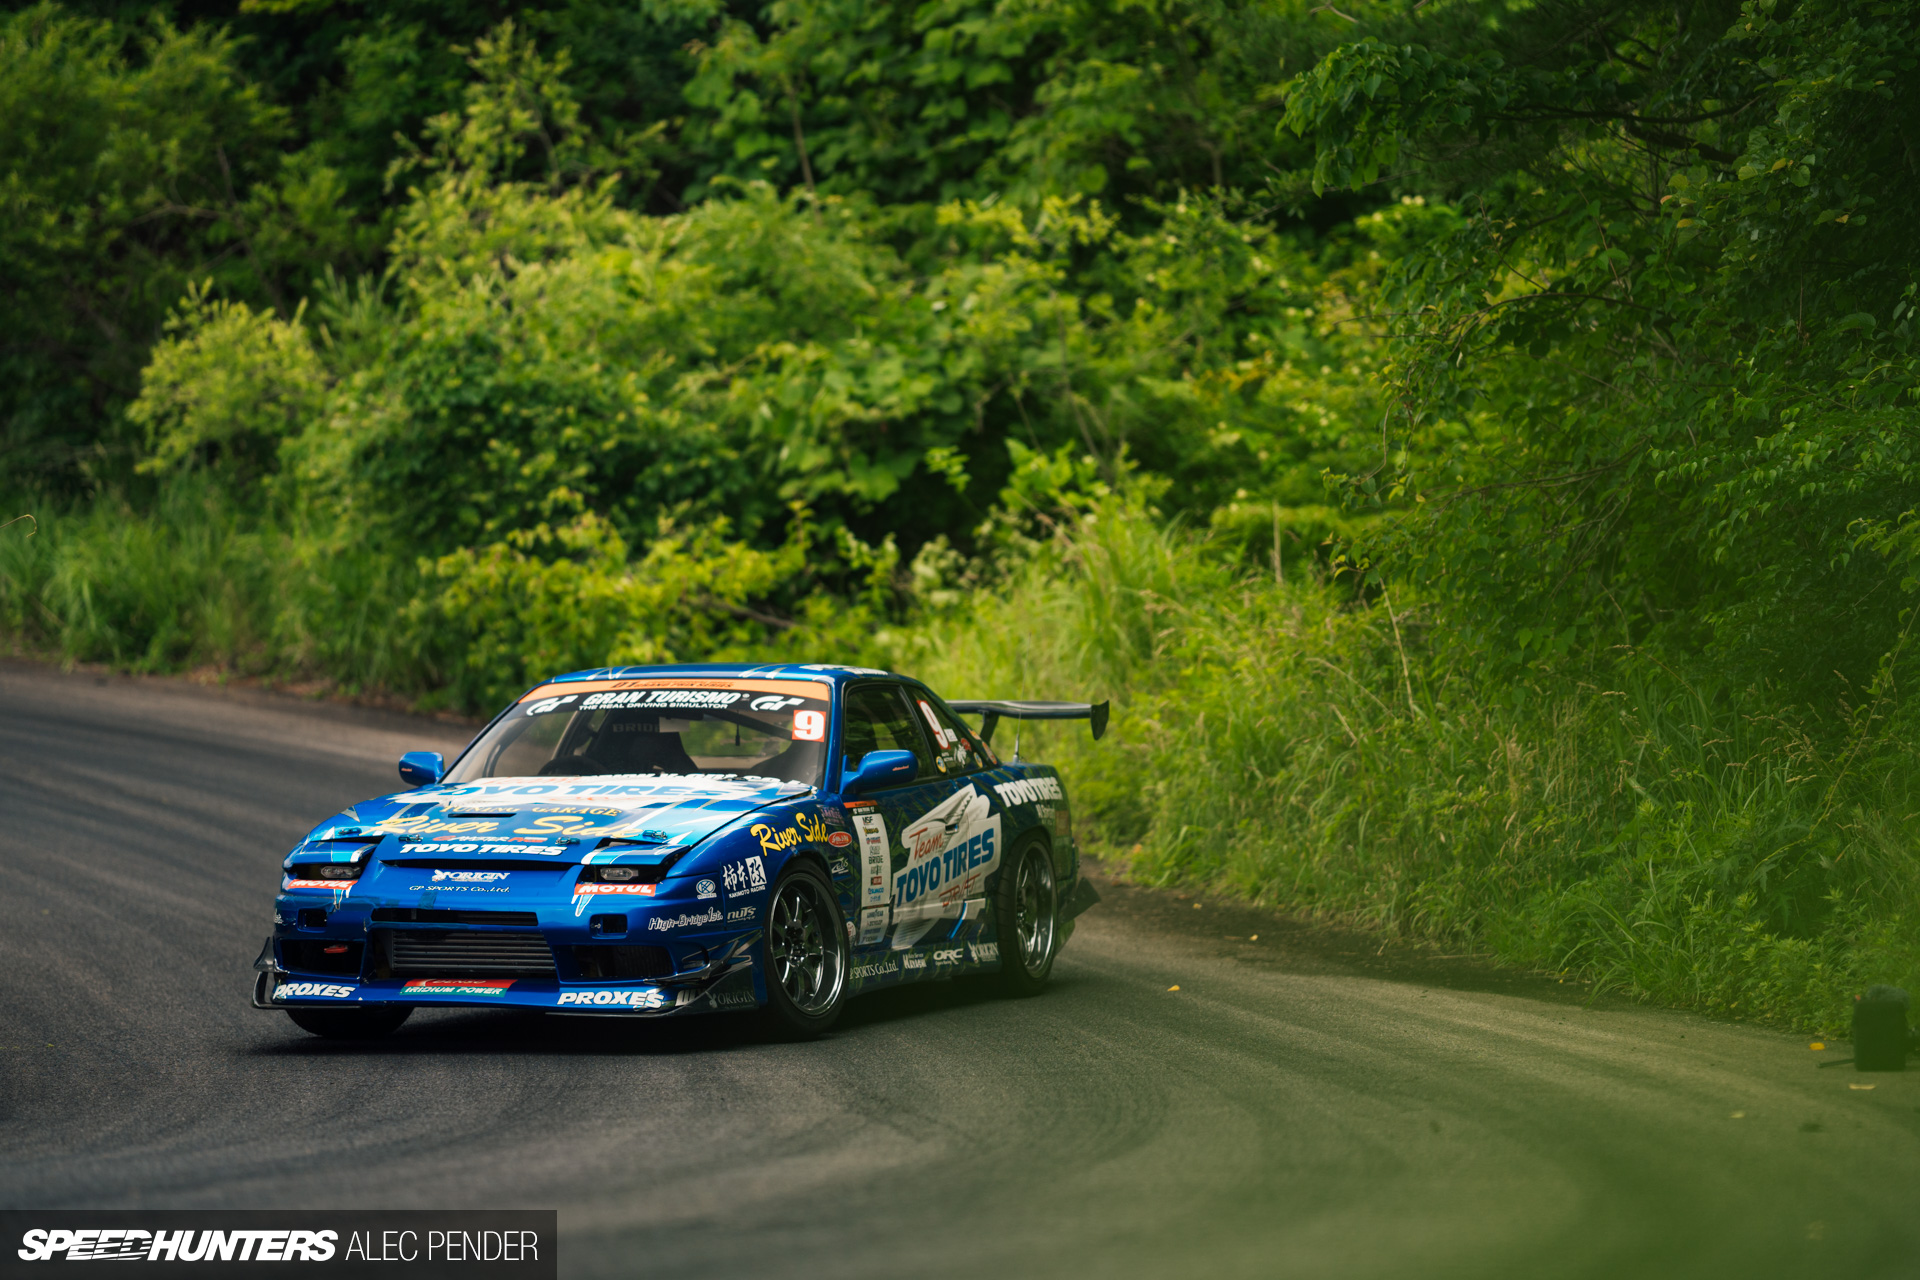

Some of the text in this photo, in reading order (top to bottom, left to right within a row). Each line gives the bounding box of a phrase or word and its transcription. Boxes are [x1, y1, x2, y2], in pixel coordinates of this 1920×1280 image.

[583, 690, 742, 706] GRAN TURISMO
[794, 710, 824, 740] 9
[920, 701, 949, 748] 9
[563, 784, 733, 796] TIRES
[993, 779, 1038, 808] TOYO
[532, 806, 623, 817] GARAGE
[359, 815, 644, 838] River Side
[750, 823, 803, 856] River
[796, 812, 830, 842] Side
[400, 843, 568, 857] TOYO TIRES
[909, 827, 944, 860] Team
[448, 871, 511, 880] ORIGIN
[896, 827, 995, 908] TOYO TIRES
[290, 880, 353, 888] MOTUL
[578, 883, 652, 894] MOTUL
[728, 888, 750, 899] KAKIMOTO
[750, 884, 766, 894] RACING
[933, 948, 964, 965] ORC
[854, 964, 876, 979] SPORTS
[272, 983, 355, 999] PROXES
[456, 986, 503, 995] POWER
[557, 990, 665, 1009] PROXES
